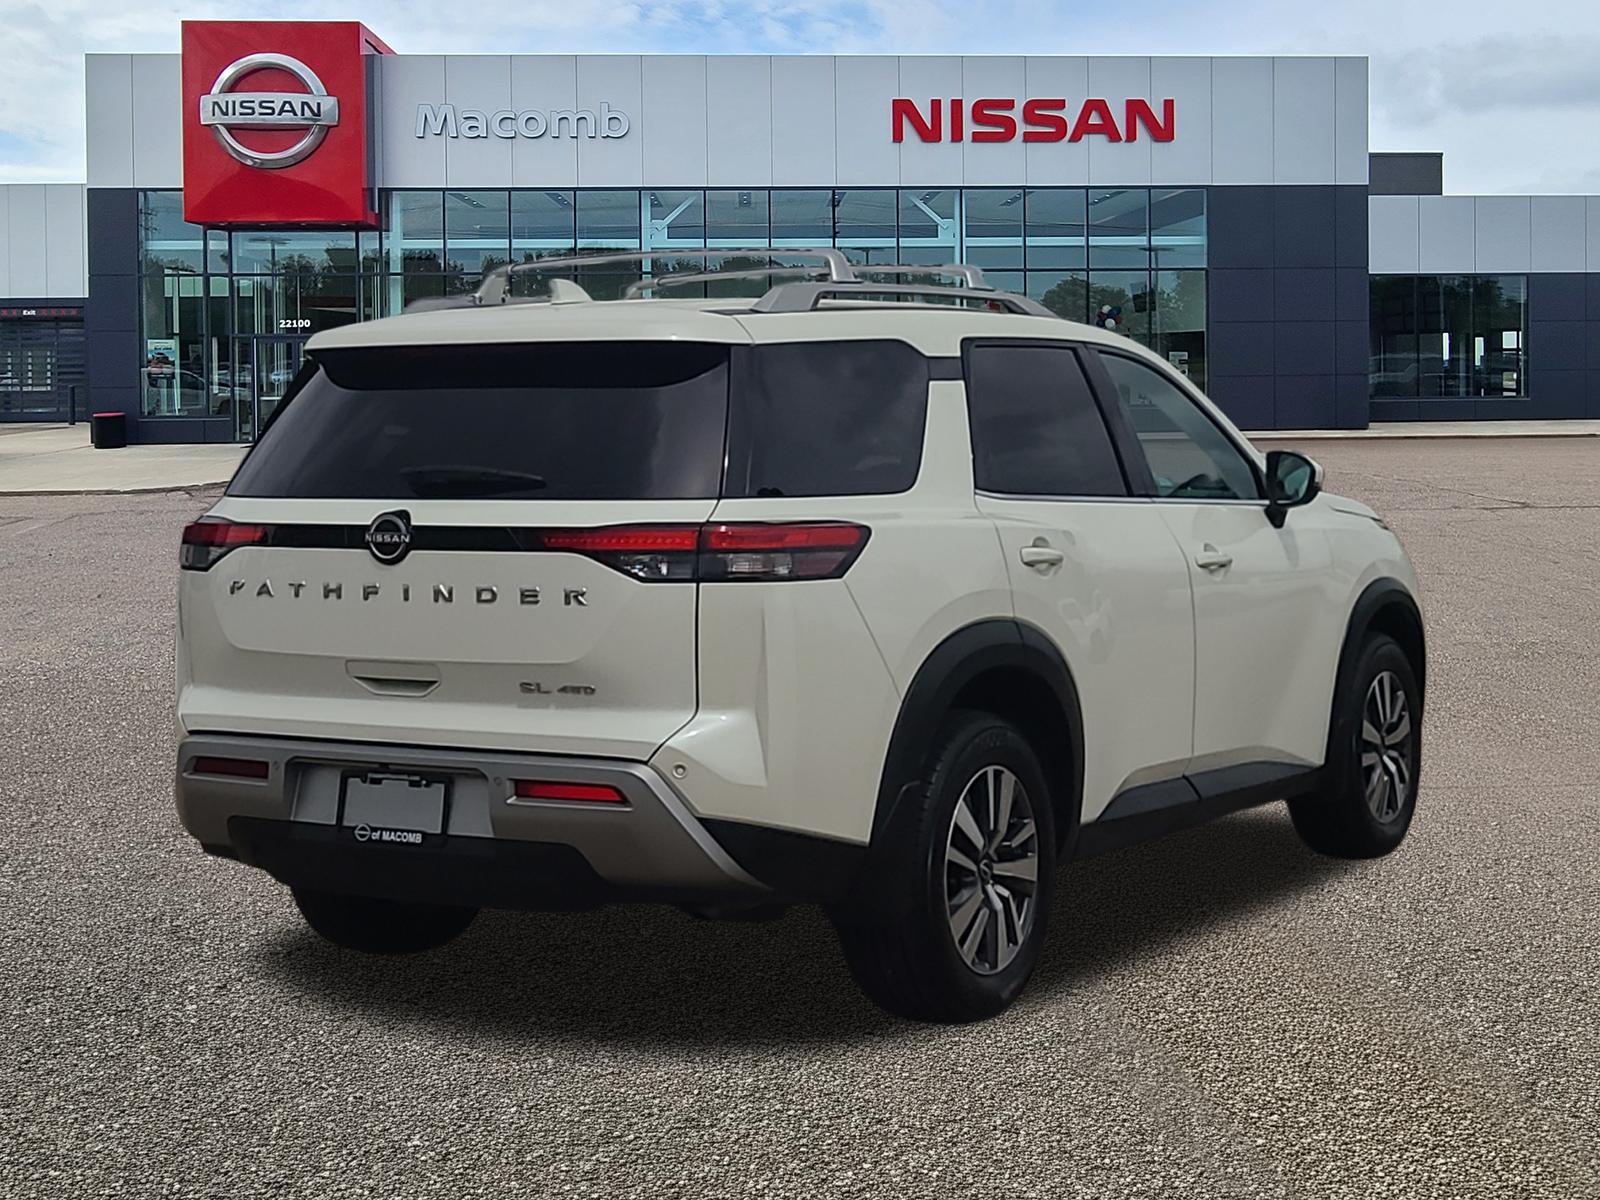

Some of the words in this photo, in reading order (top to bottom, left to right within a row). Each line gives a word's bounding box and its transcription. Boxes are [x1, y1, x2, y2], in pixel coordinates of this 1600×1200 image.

[211, 100, 322, 118] NISSAN
[415, 102, 630, 139] Macomb
[892, 98, 1176, 143] NISSAN
[279, 319, 311, 328] 22100
[364, 533, 410, 544] NISSAN
[229, 578, 589, 606] PATHFINDER
[519, 681, 552, 694] SL
[381, 831, 422, 844] MACOMB
